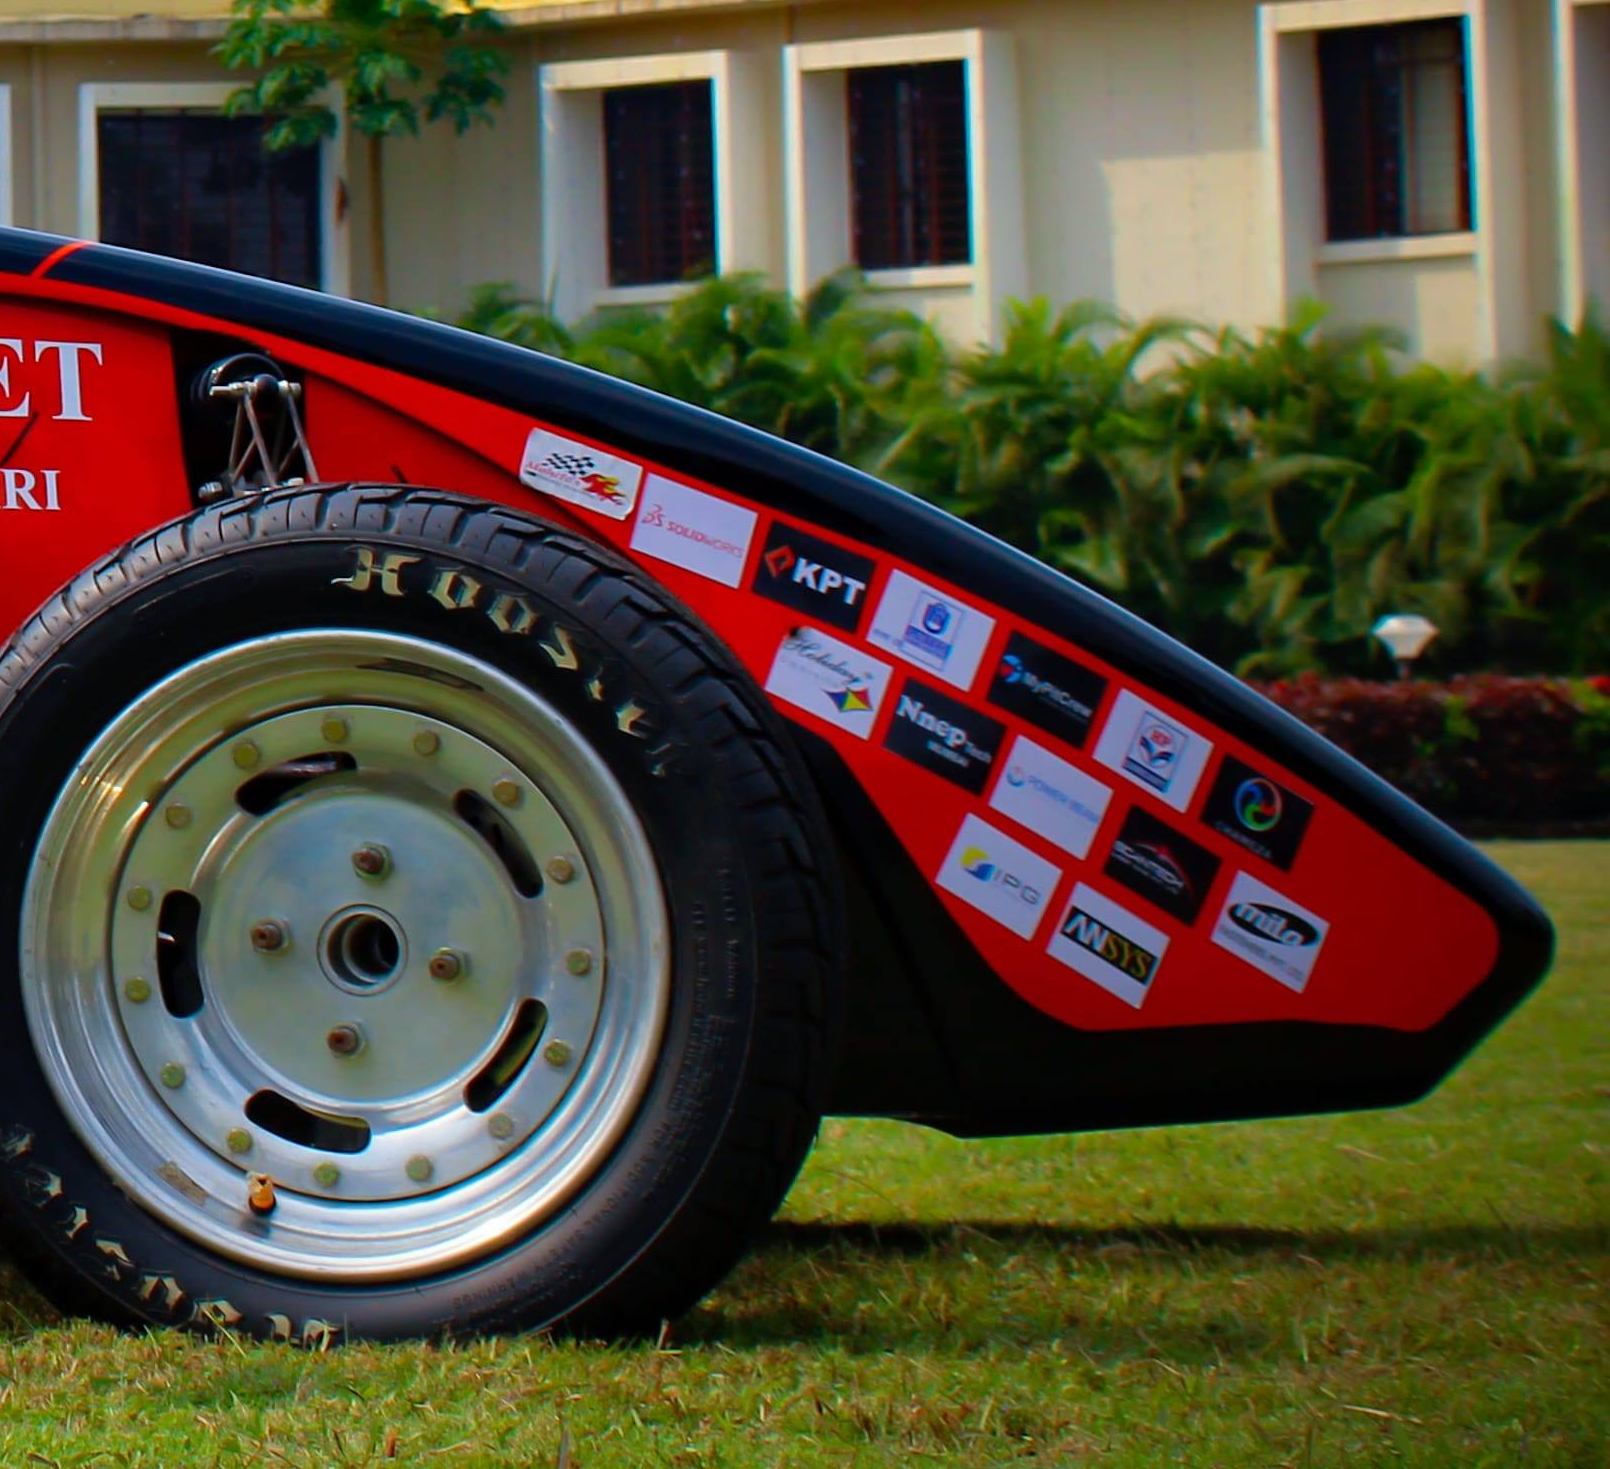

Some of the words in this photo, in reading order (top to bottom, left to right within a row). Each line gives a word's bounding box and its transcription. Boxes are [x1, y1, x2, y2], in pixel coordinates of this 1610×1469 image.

[666, 521, 745, 559] SOLIDWORKS
[792, 556, 867, 606] KPT
[994, 870, 1042, 907] IPG
[1063, 912, 1152, 980] ANSYS
